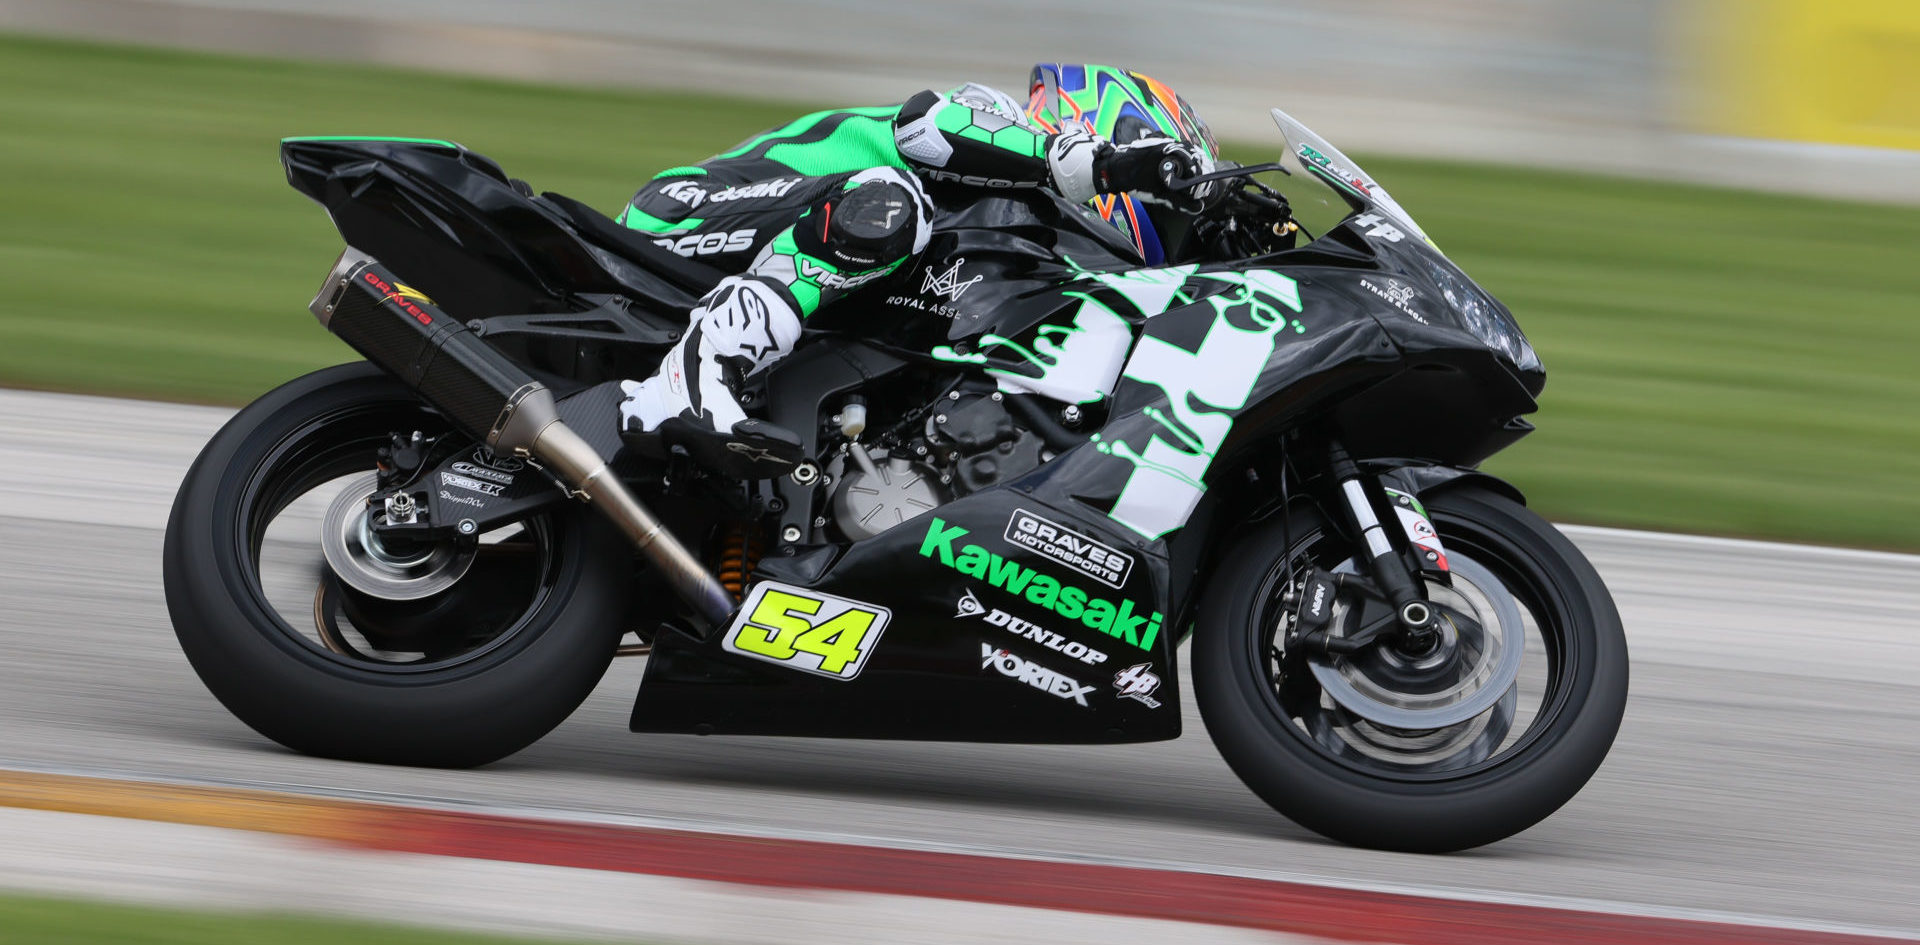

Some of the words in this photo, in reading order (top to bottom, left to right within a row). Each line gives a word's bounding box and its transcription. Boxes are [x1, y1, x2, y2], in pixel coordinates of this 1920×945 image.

[364, 272, 433, 326] GRAVES
[886, 296, 925, 310] ROYAL
[1013, 530, 1119, 582] MOTORSPORTS
[1018, 516, 1125, 572] GRAVES
[918, 517, 1164, 652] Kawasaki
[733, 588, 878, 675] 54
[983, 608, 1108, 666] DUNLOP
[981, 642, 1097, 708] VORTEX
